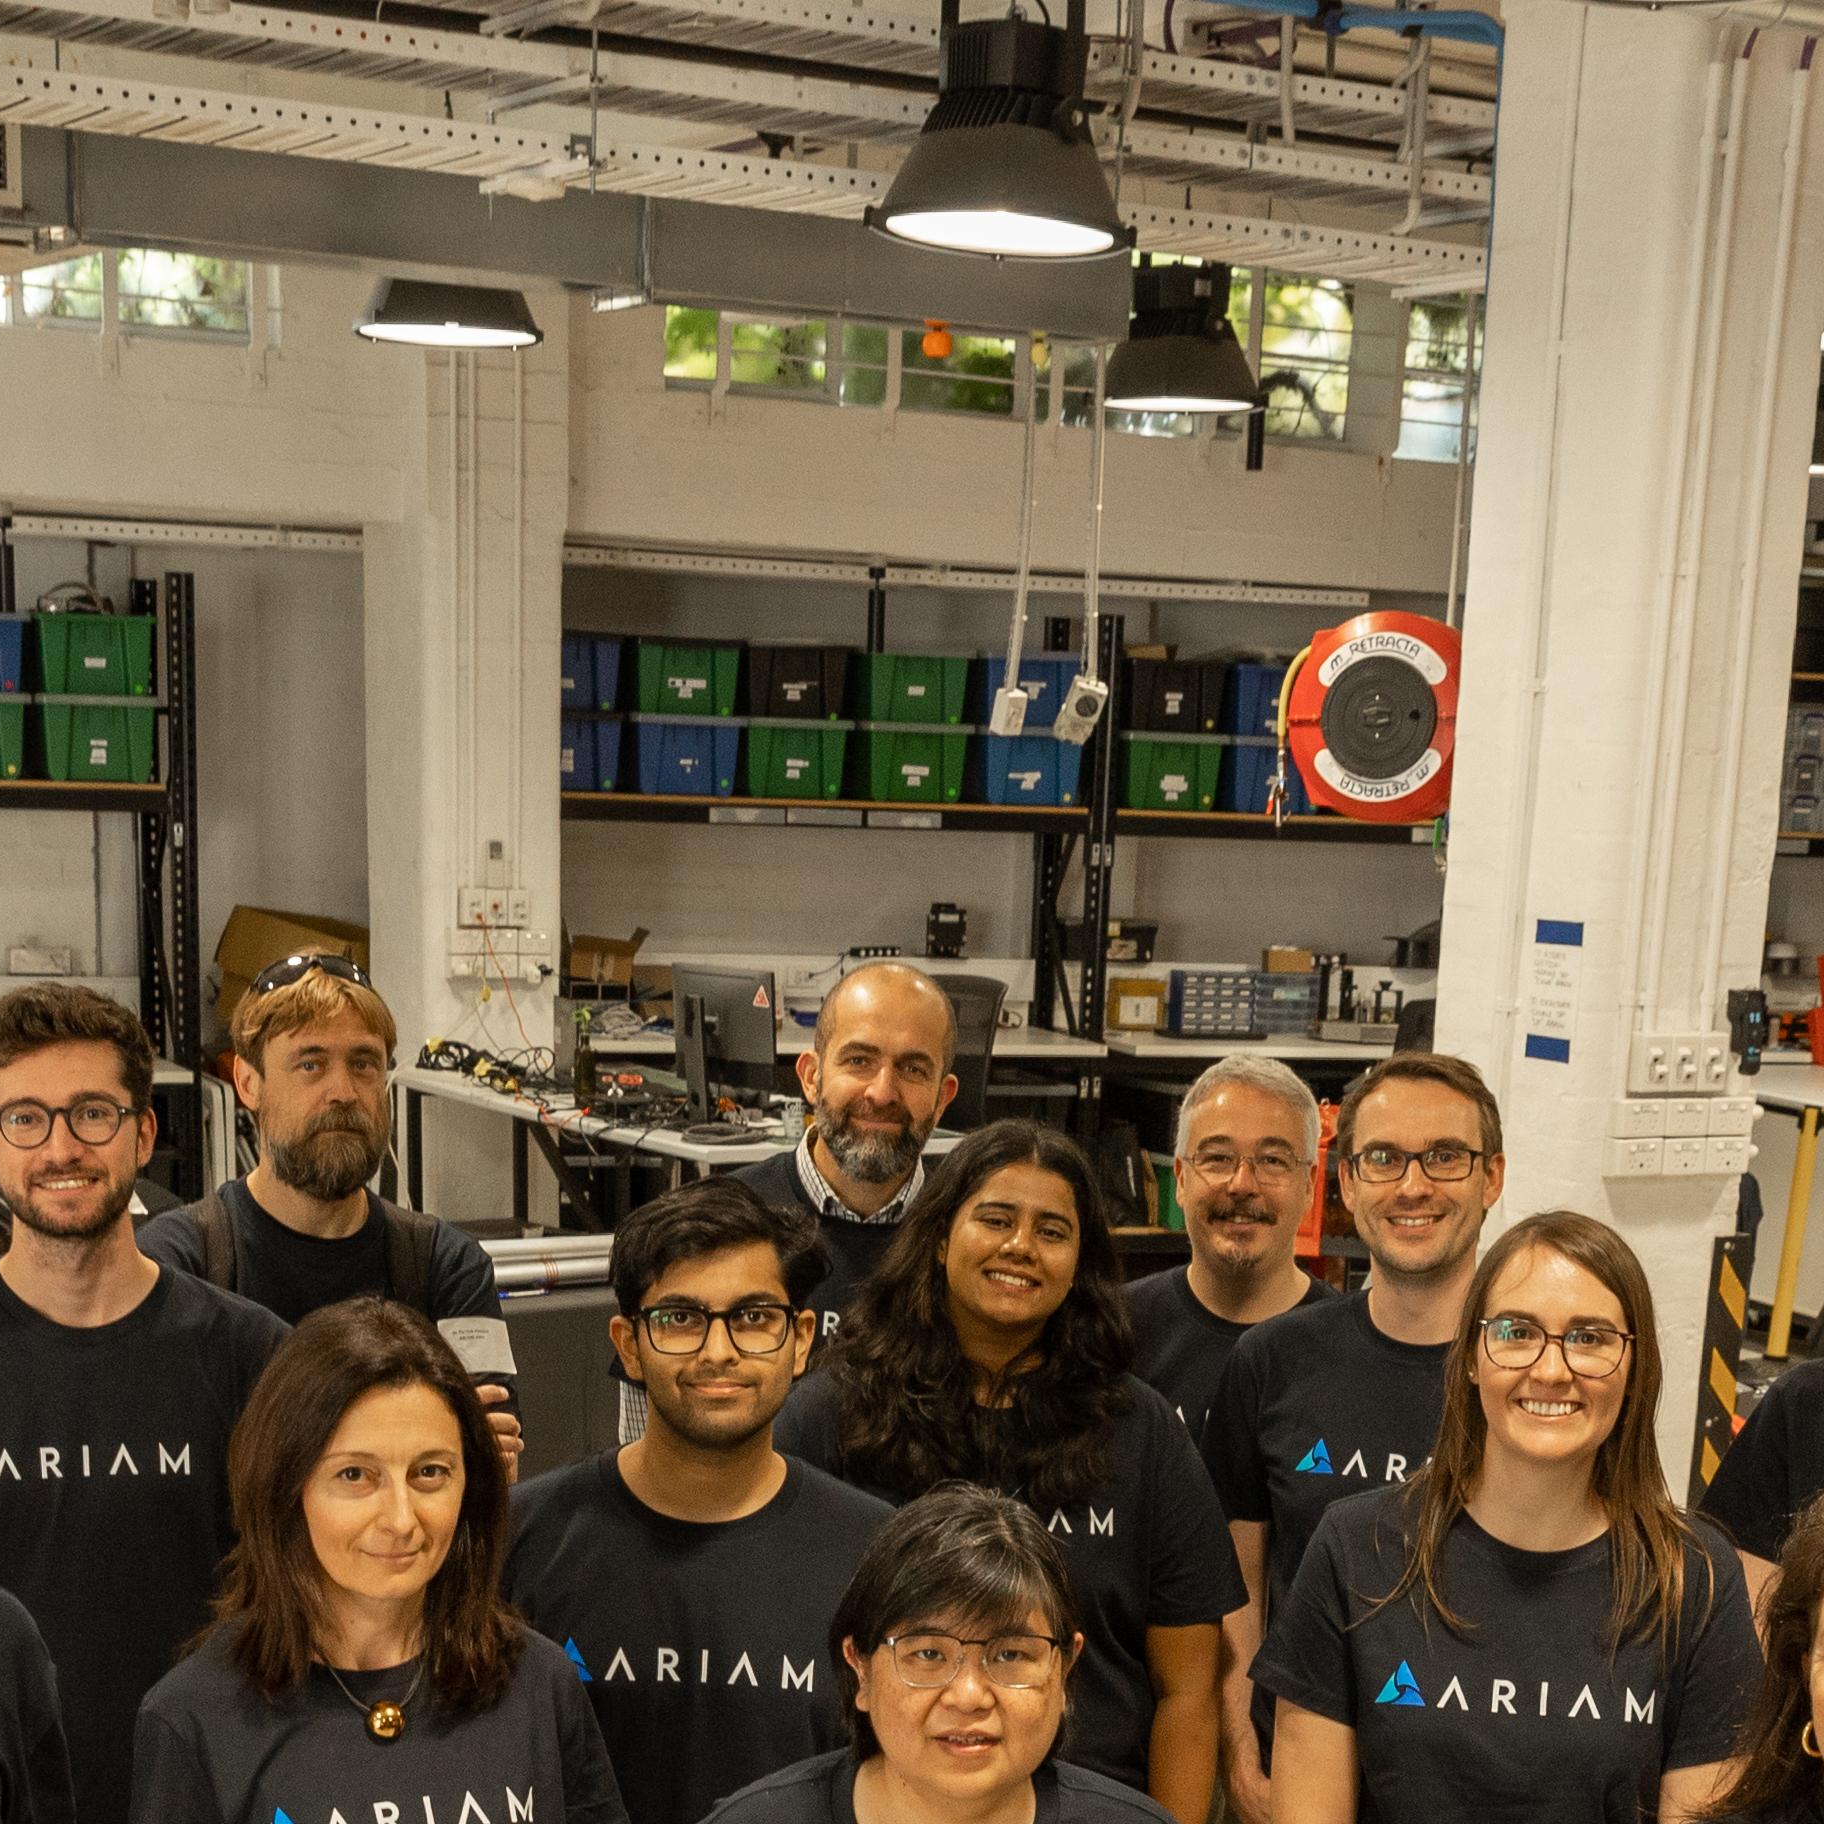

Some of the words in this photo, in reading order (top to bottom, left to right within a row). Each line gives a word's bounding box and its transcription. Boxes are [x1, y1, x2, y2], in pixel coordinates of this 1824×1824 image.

[1349, 636, 1421, 656] RETRACTA
[1339, 776, 1411, 798] RETRACTA
[604, 1647, 814, 1692] ARIAM
[1436, 1675, 1656, 1725] ARIAM
